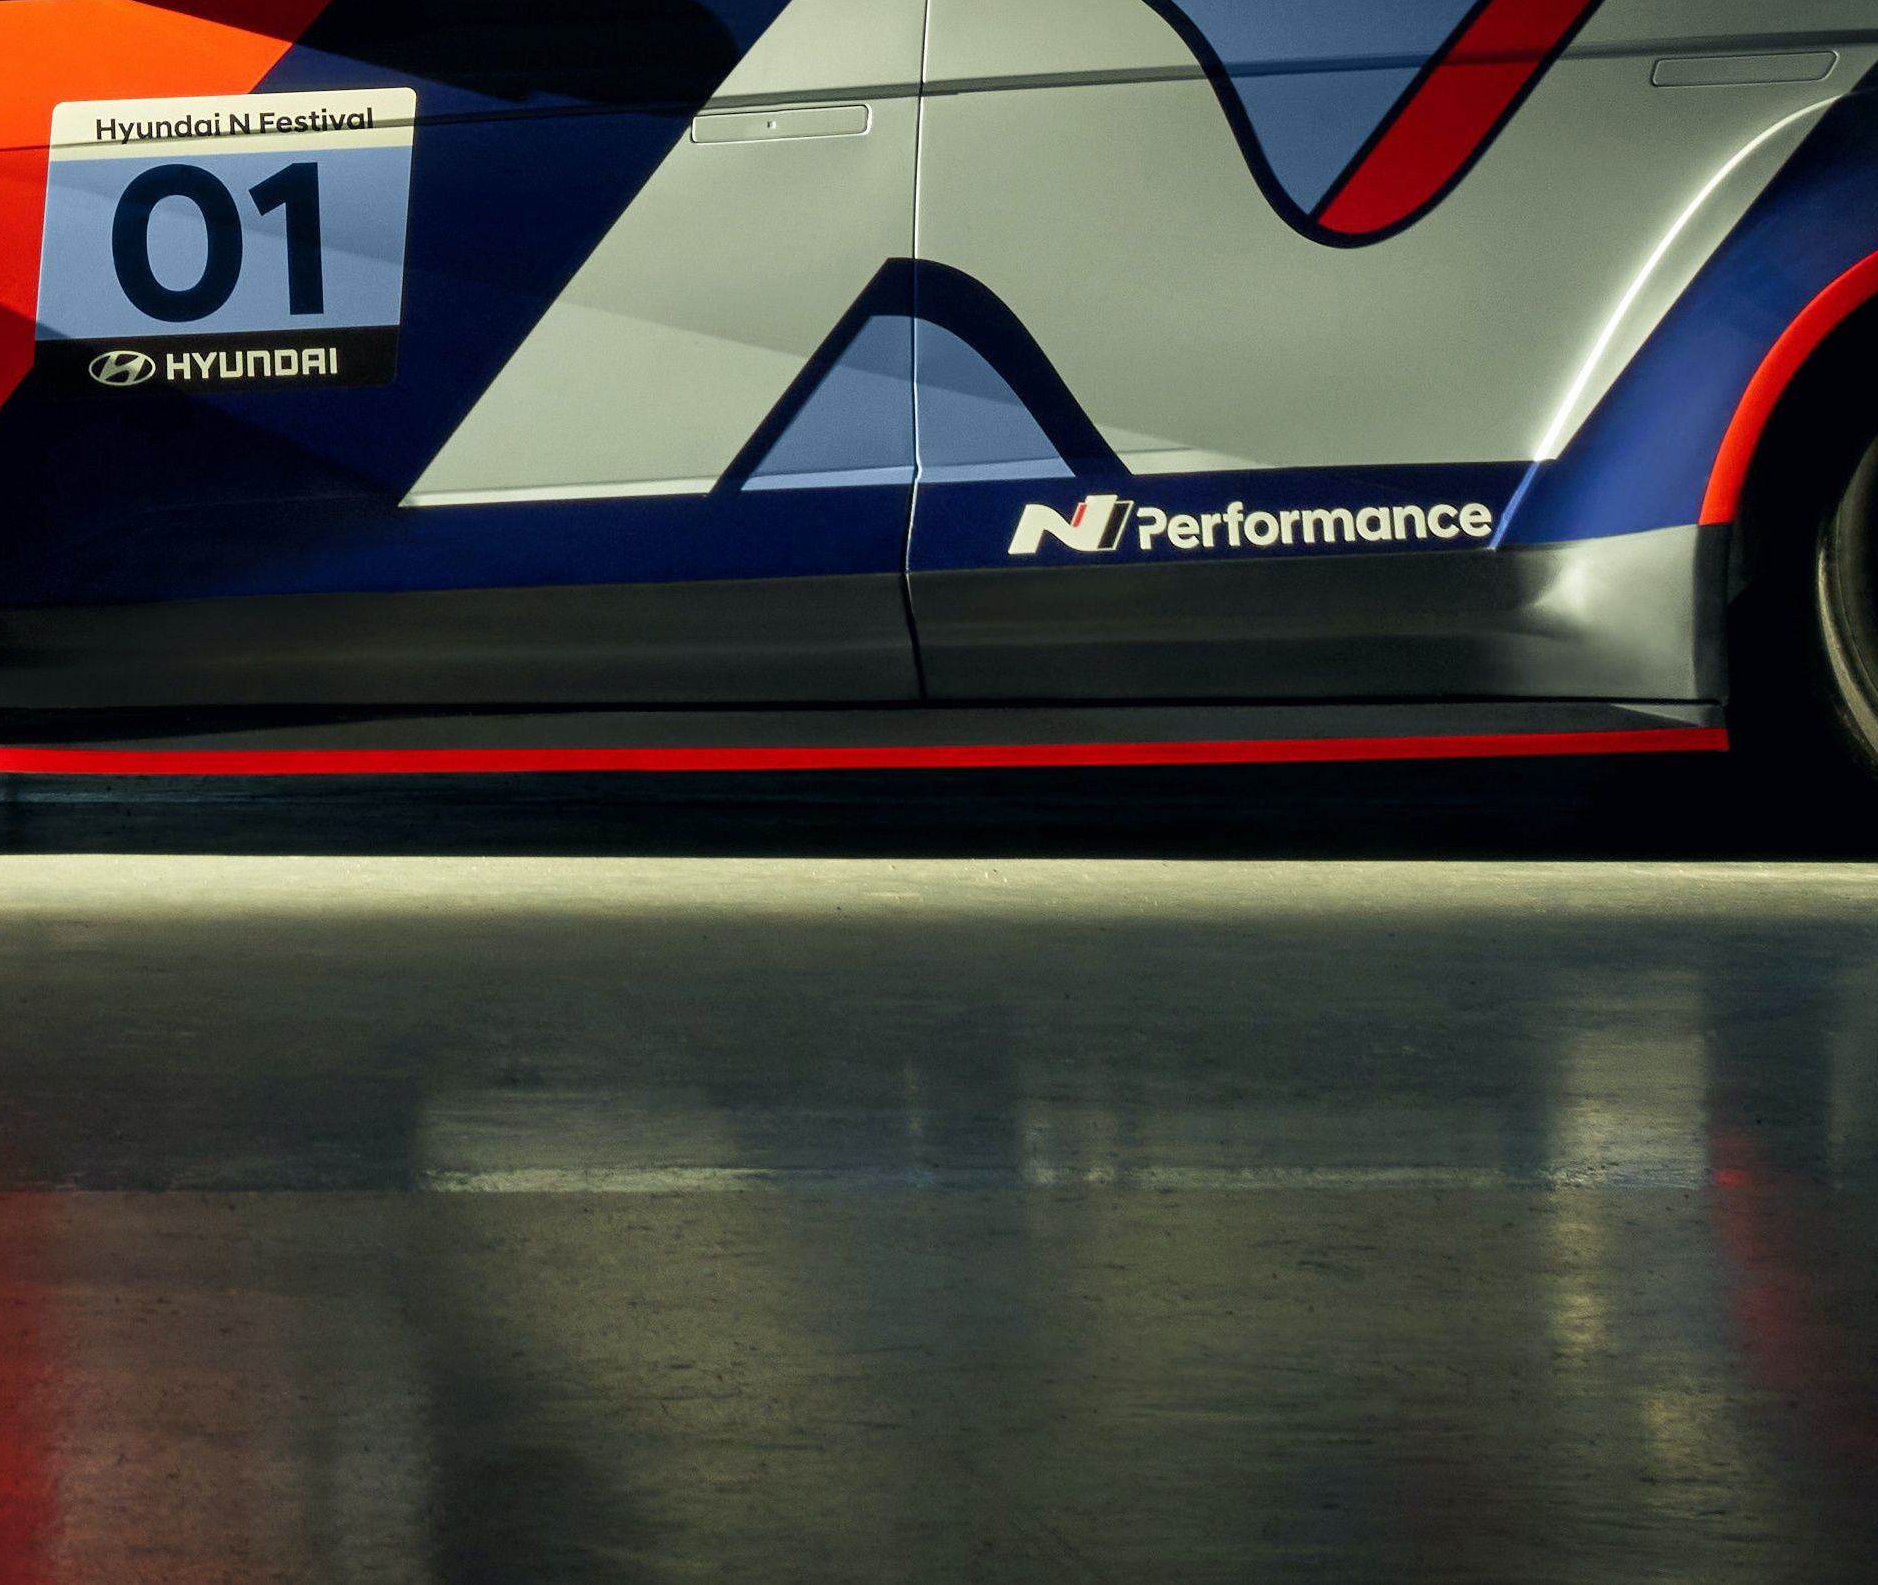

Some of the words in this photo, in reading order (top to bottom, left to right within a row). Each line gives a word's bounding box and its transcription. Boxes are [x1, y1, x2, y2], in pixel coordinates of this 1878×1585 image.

[95, 112, 221, 145] Hyundai
[228, 113, 251, 135] N
[259, 108, 374, 133] Festival
[111, 161, 325, 323] 01
[166, 347, 338, 381] HYUNDAI
[1008, 493, 1134, 554] N
[1136, 501, 1493, 550] Performance
